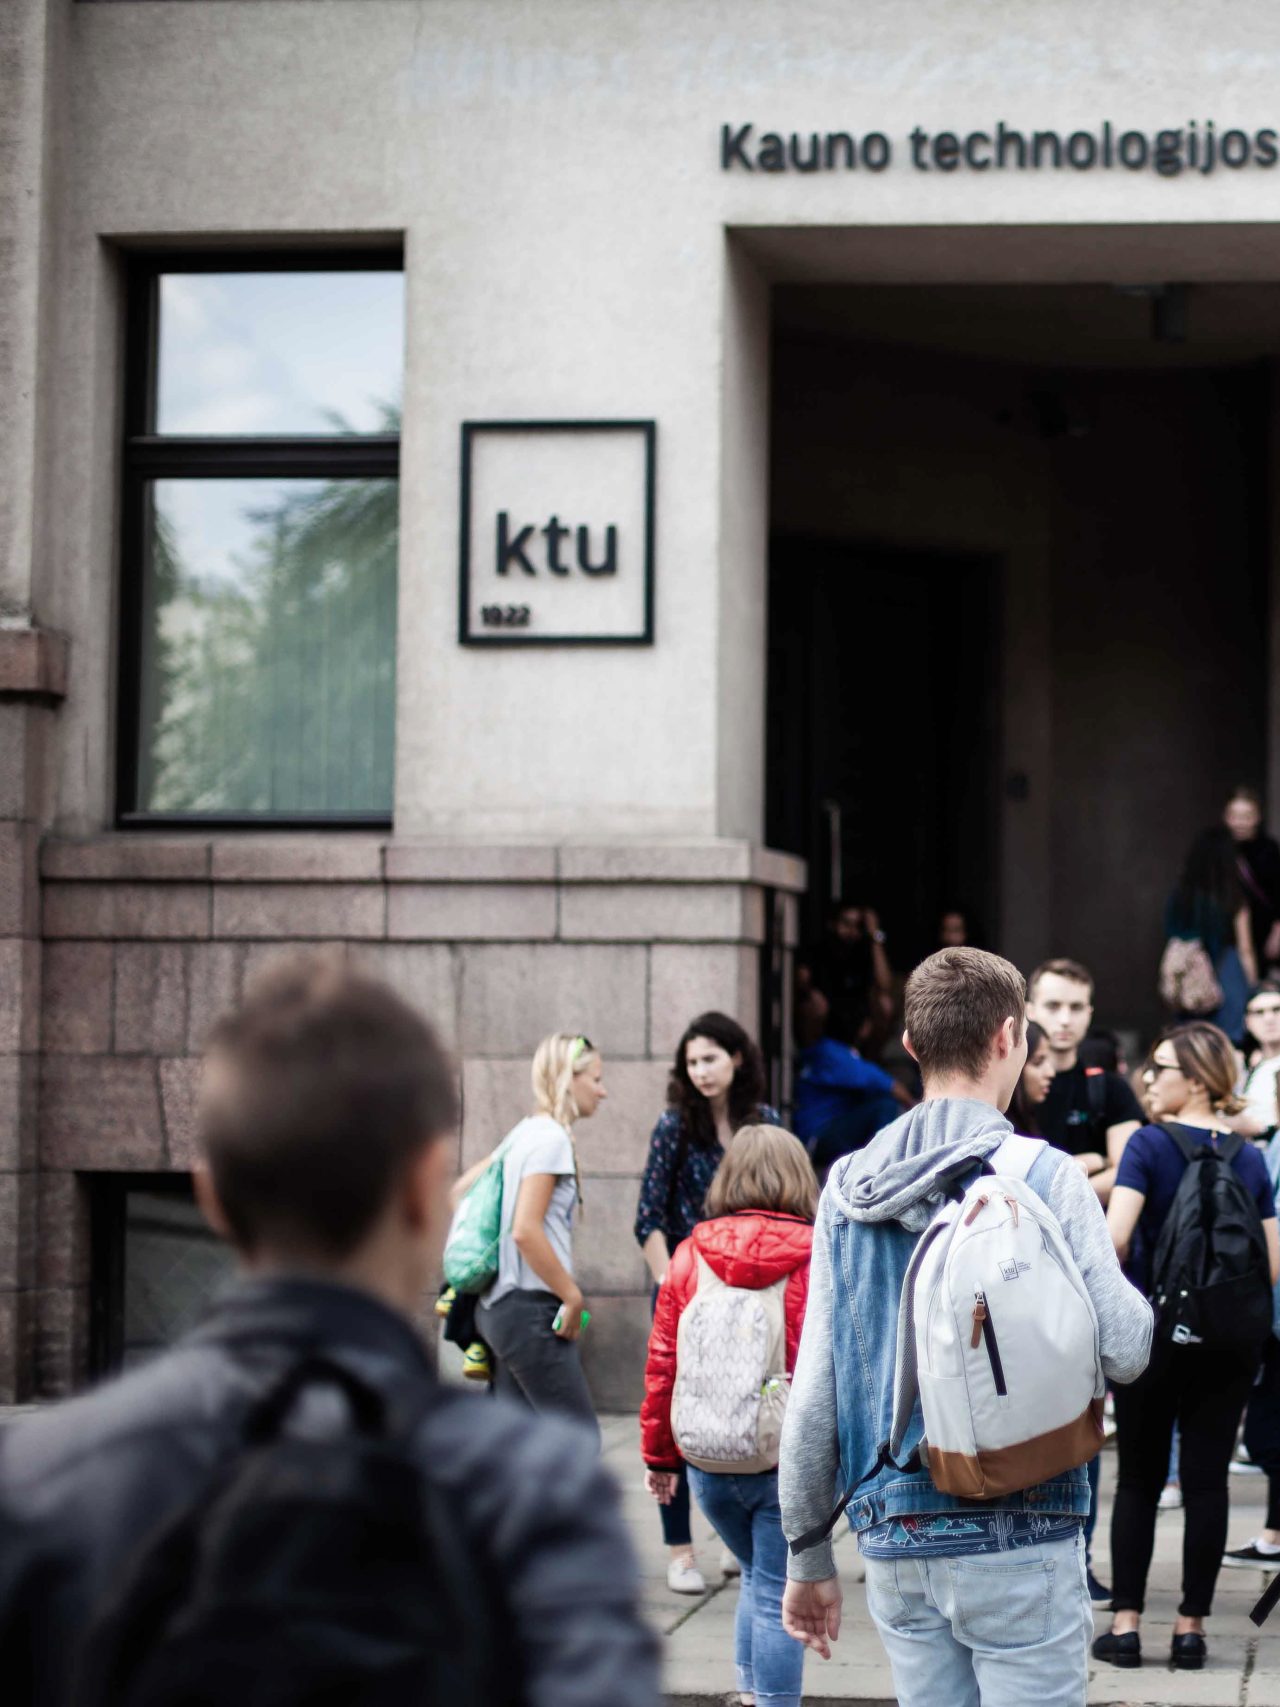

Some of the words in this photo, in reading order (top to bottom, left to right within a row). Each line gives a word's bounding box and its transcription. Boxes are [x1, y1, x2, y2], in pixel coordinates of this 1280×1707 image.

[720, 122, 891, 171] Kauno
[909, 119, 1280, 175] technologijos
[496, 510, 618, 577] ktu
[481, 604, 531, 627] 1922
